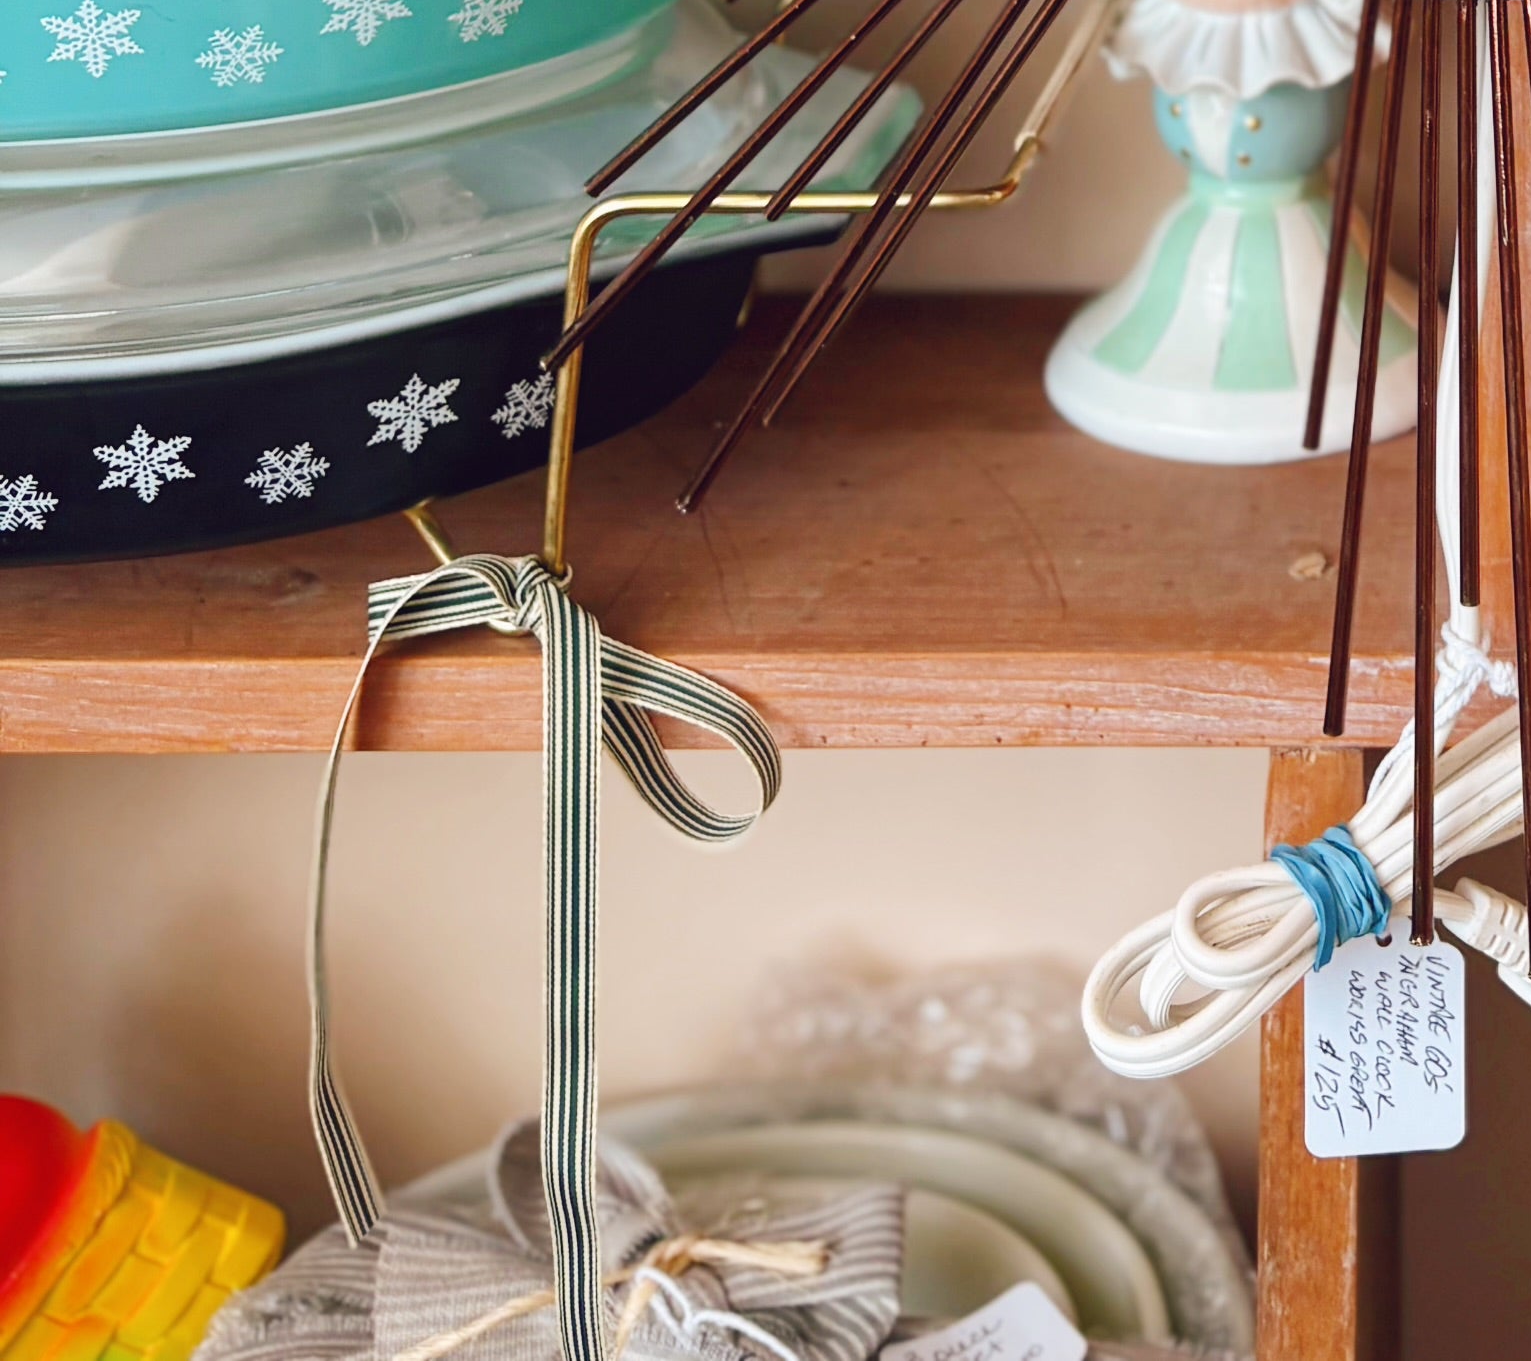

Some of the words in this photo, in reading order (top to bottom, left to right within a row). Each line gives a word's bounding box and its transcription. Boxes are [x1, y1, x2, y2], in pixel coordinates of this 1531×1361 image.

[1374, 970, 1393, 1031] WALL
[1396, 954, 1423, 1067] INGRAHAM
[1425, 953, 1456, 1043] VINTAGE
[1349, 1050, 1373, 1132] GREAT
[1374, 1039, 1396, 1119] CLOCK
